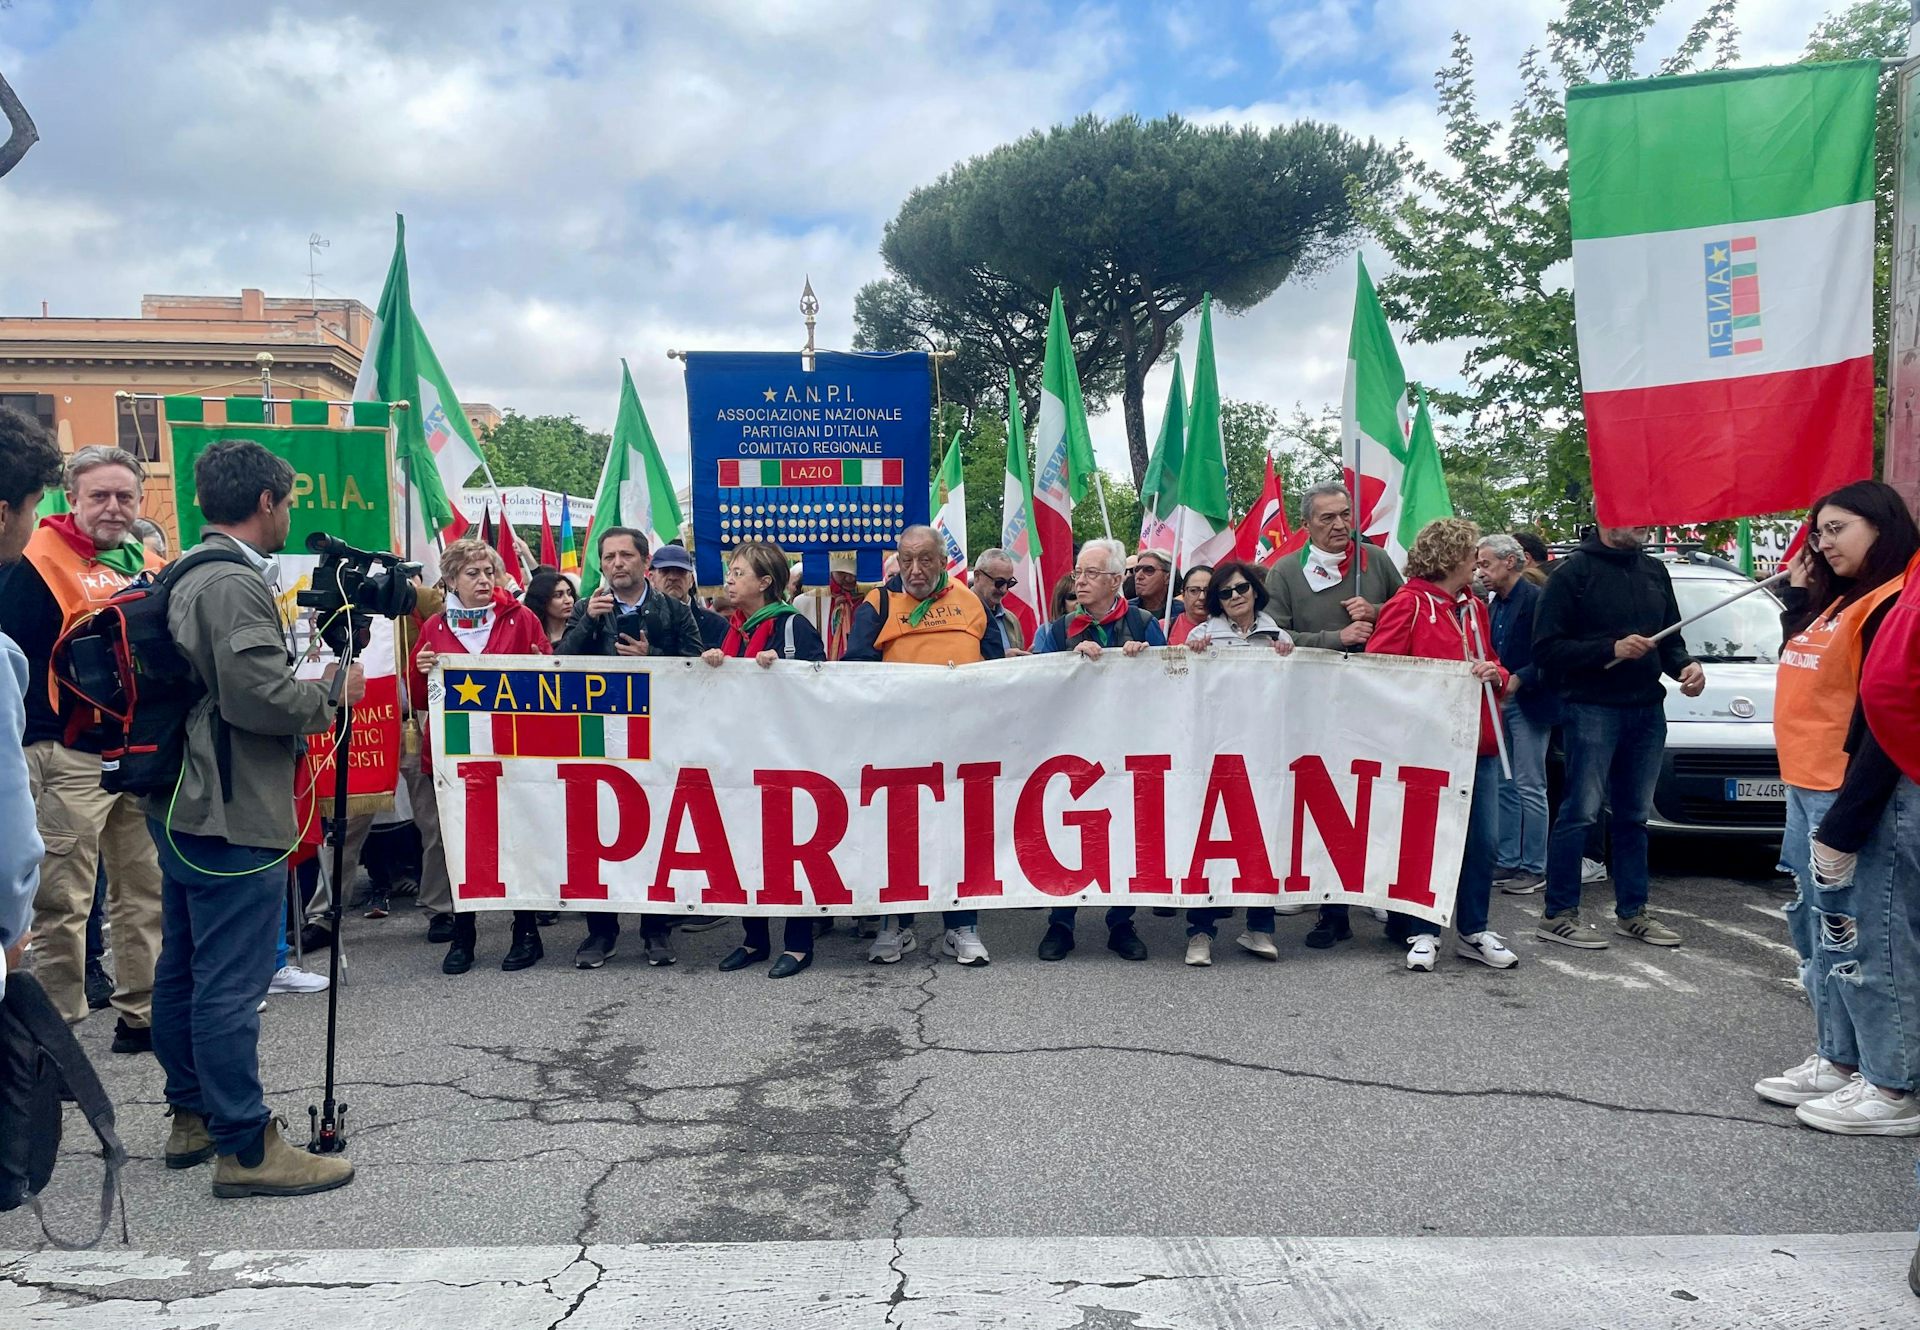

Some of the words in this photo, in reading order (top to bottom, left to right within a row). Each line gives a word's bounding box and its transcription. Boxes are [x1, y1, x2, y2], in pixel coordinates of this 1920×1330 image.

[717, 408, 821, 421] ASSOCIAZIONE
[825, 408, 902, 421] NAZIONALE
[743, 425, 820, 438] PARTIGIANI
[824, 425, 879, 437] D'ITALIA
[738, 442, 809, 455] COMITATO
[813, 441, 882, 454] REGIONALE
[790, 466, 833, 479] LAZIO
[290, 473, 375, 510] P.I.A.
[923, 619, 947, 628] Roma
[494, 673, 649, 714] A.N.P.I.
[457, 760, 506, 900] I
[557, 754, 1450, 908] PARTIGIANI
